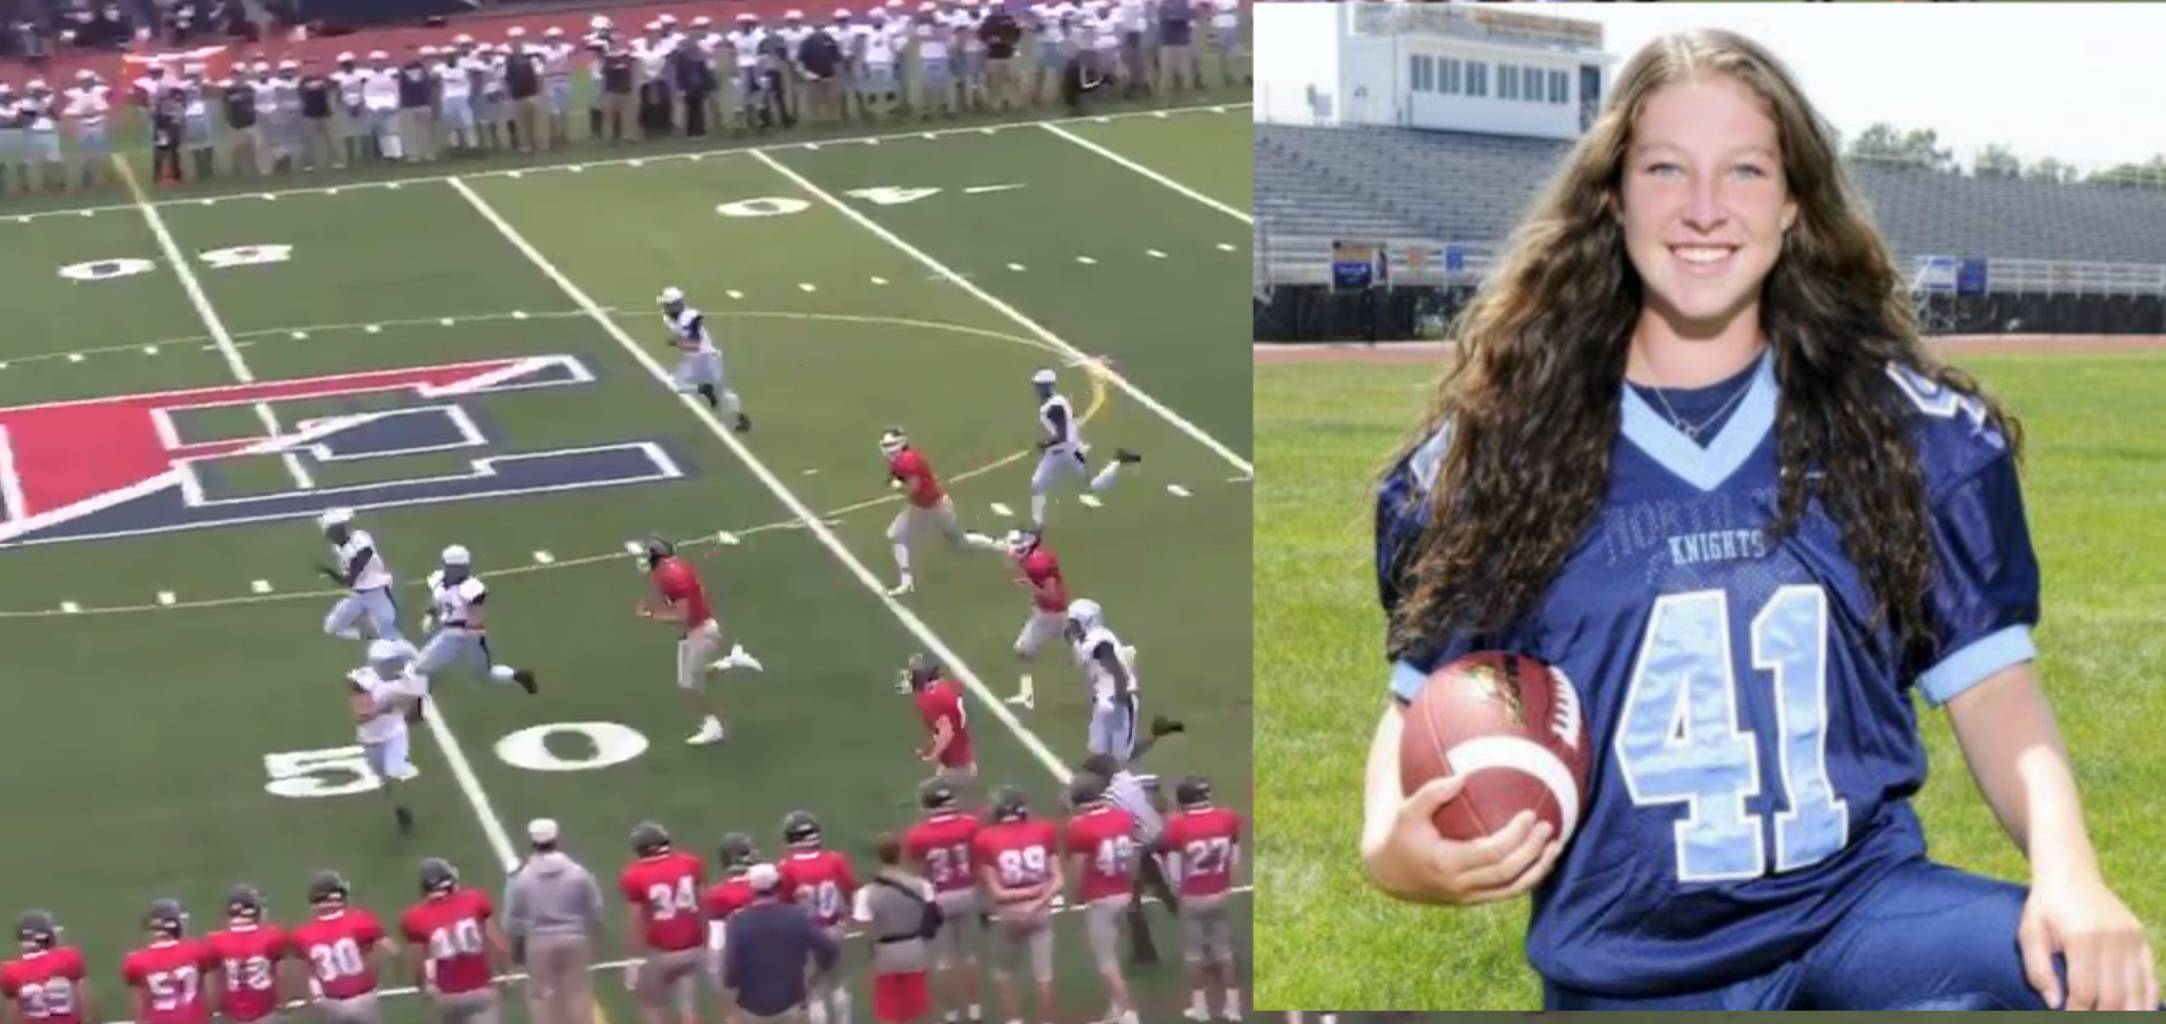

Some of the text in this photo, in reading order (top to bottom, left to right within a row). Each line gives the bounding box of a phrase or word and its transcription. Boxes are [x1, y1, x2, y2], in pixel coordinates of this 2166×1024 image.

[1668, 528, 1766, 565] KNIGHTS
[1615, 585, 1848, 882] 41
[265, 721, 648, 797] 50
[1186, 836, 1230, 874] 27
[648, 874, 698, 919] 34
[311, 937, 364, 981] 30
[147, 965, 199, 1010] 57
